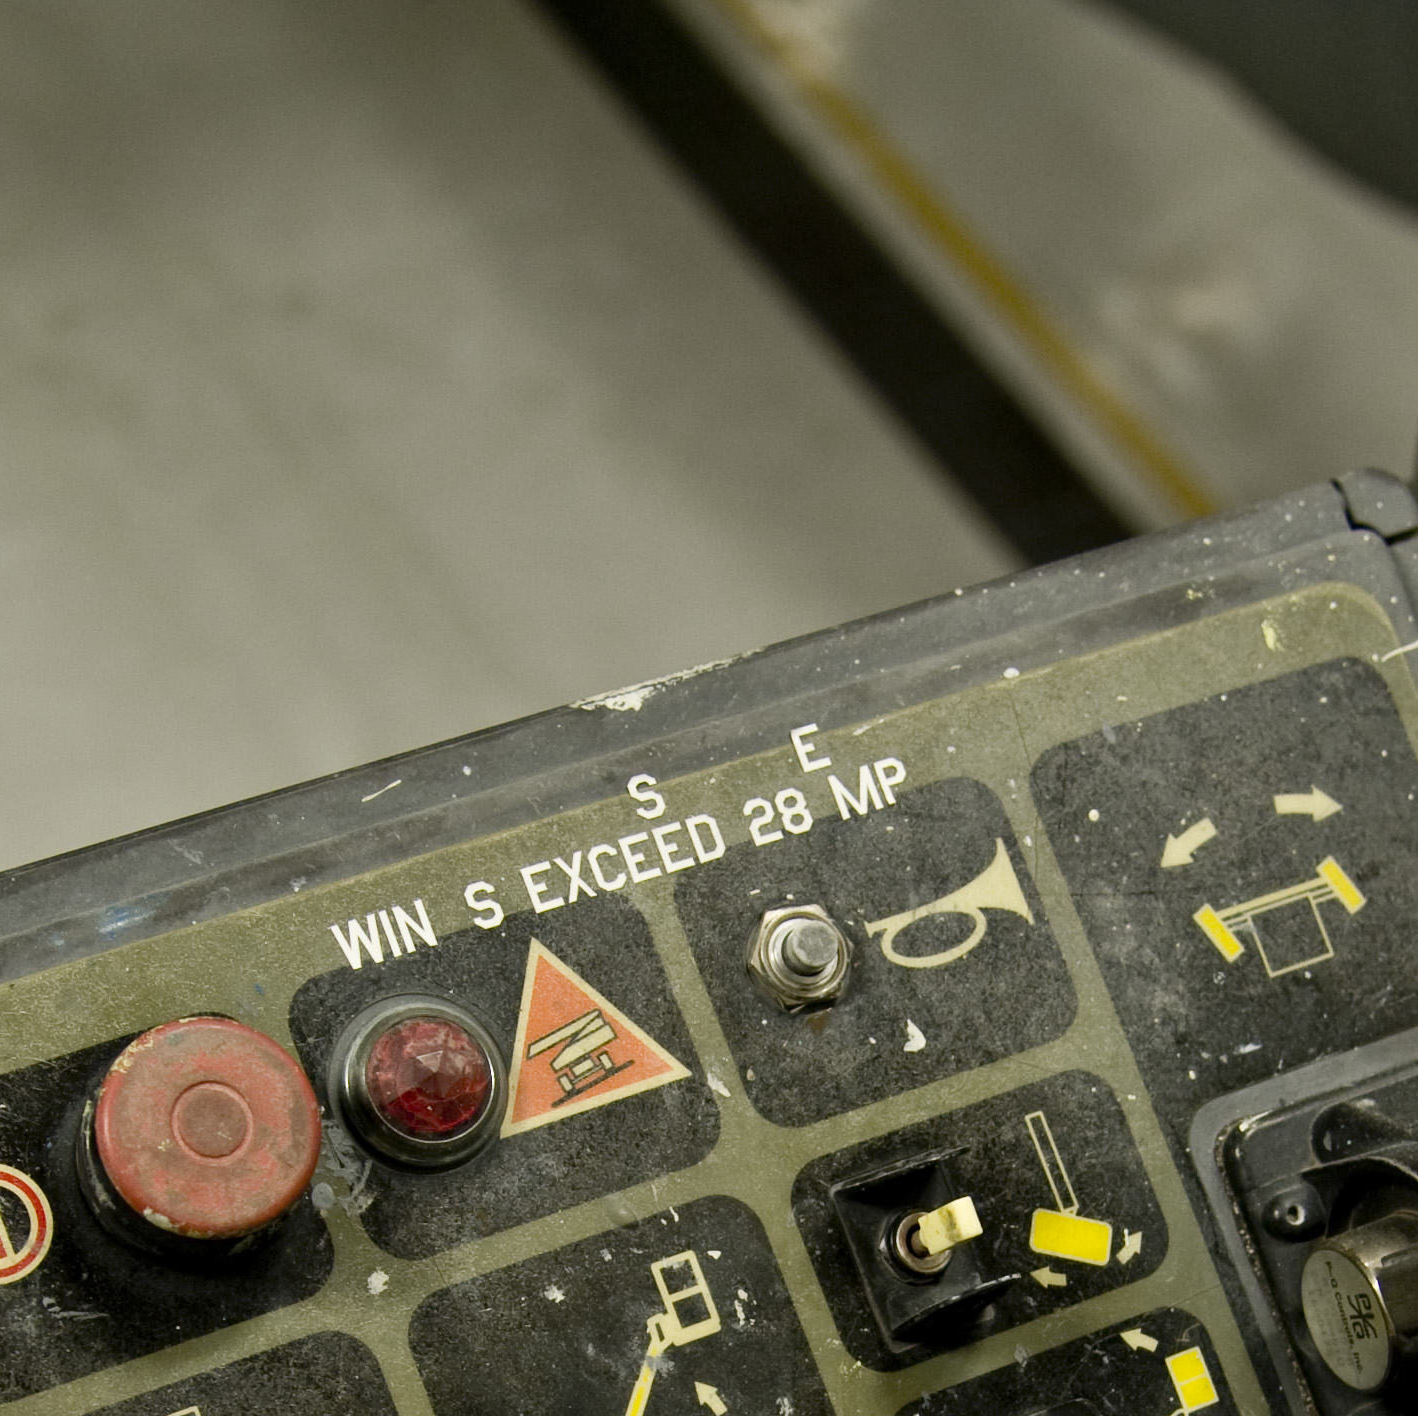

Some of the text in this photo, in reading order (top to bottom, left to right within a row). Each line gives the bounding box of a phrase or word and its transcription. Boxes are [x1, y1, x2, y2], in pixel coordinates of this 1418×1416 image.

[627, 723, 832, 820] S E
[329, 756, 907, 971] WIN S EXCEED 28 MP
